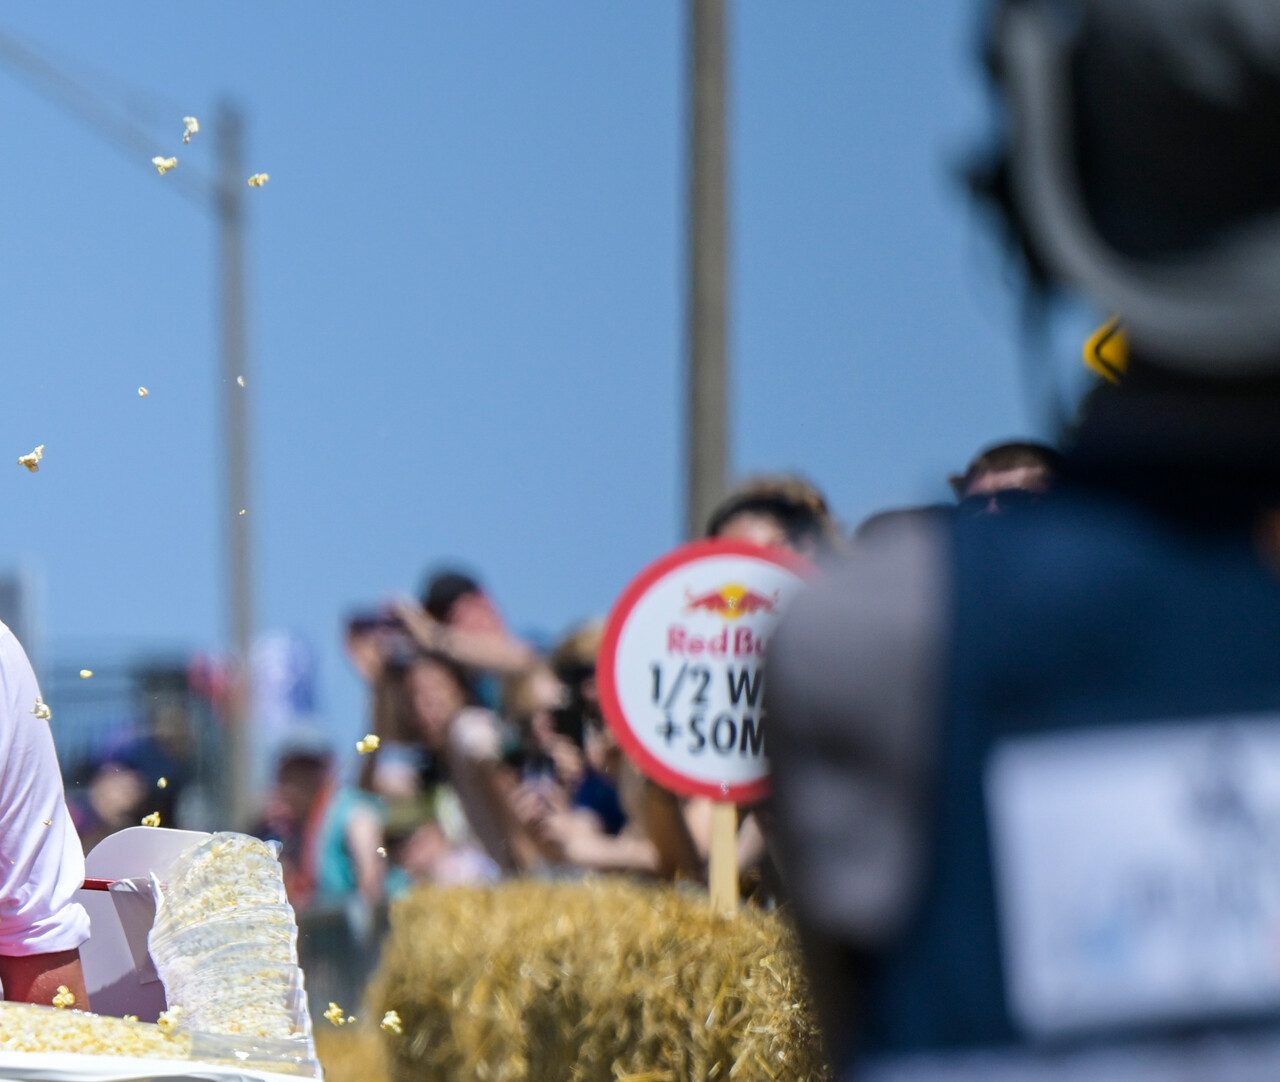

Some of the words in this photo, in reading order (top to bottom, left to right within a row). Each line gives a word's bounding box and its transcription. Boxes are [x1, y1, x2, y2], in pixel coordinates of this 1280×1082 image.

[666, 625, 729, 655] Red
[650, 661, 711, 709] 1/2
[726, 666, 764, 708] W
[656, 713, 767, 757] +SOM
